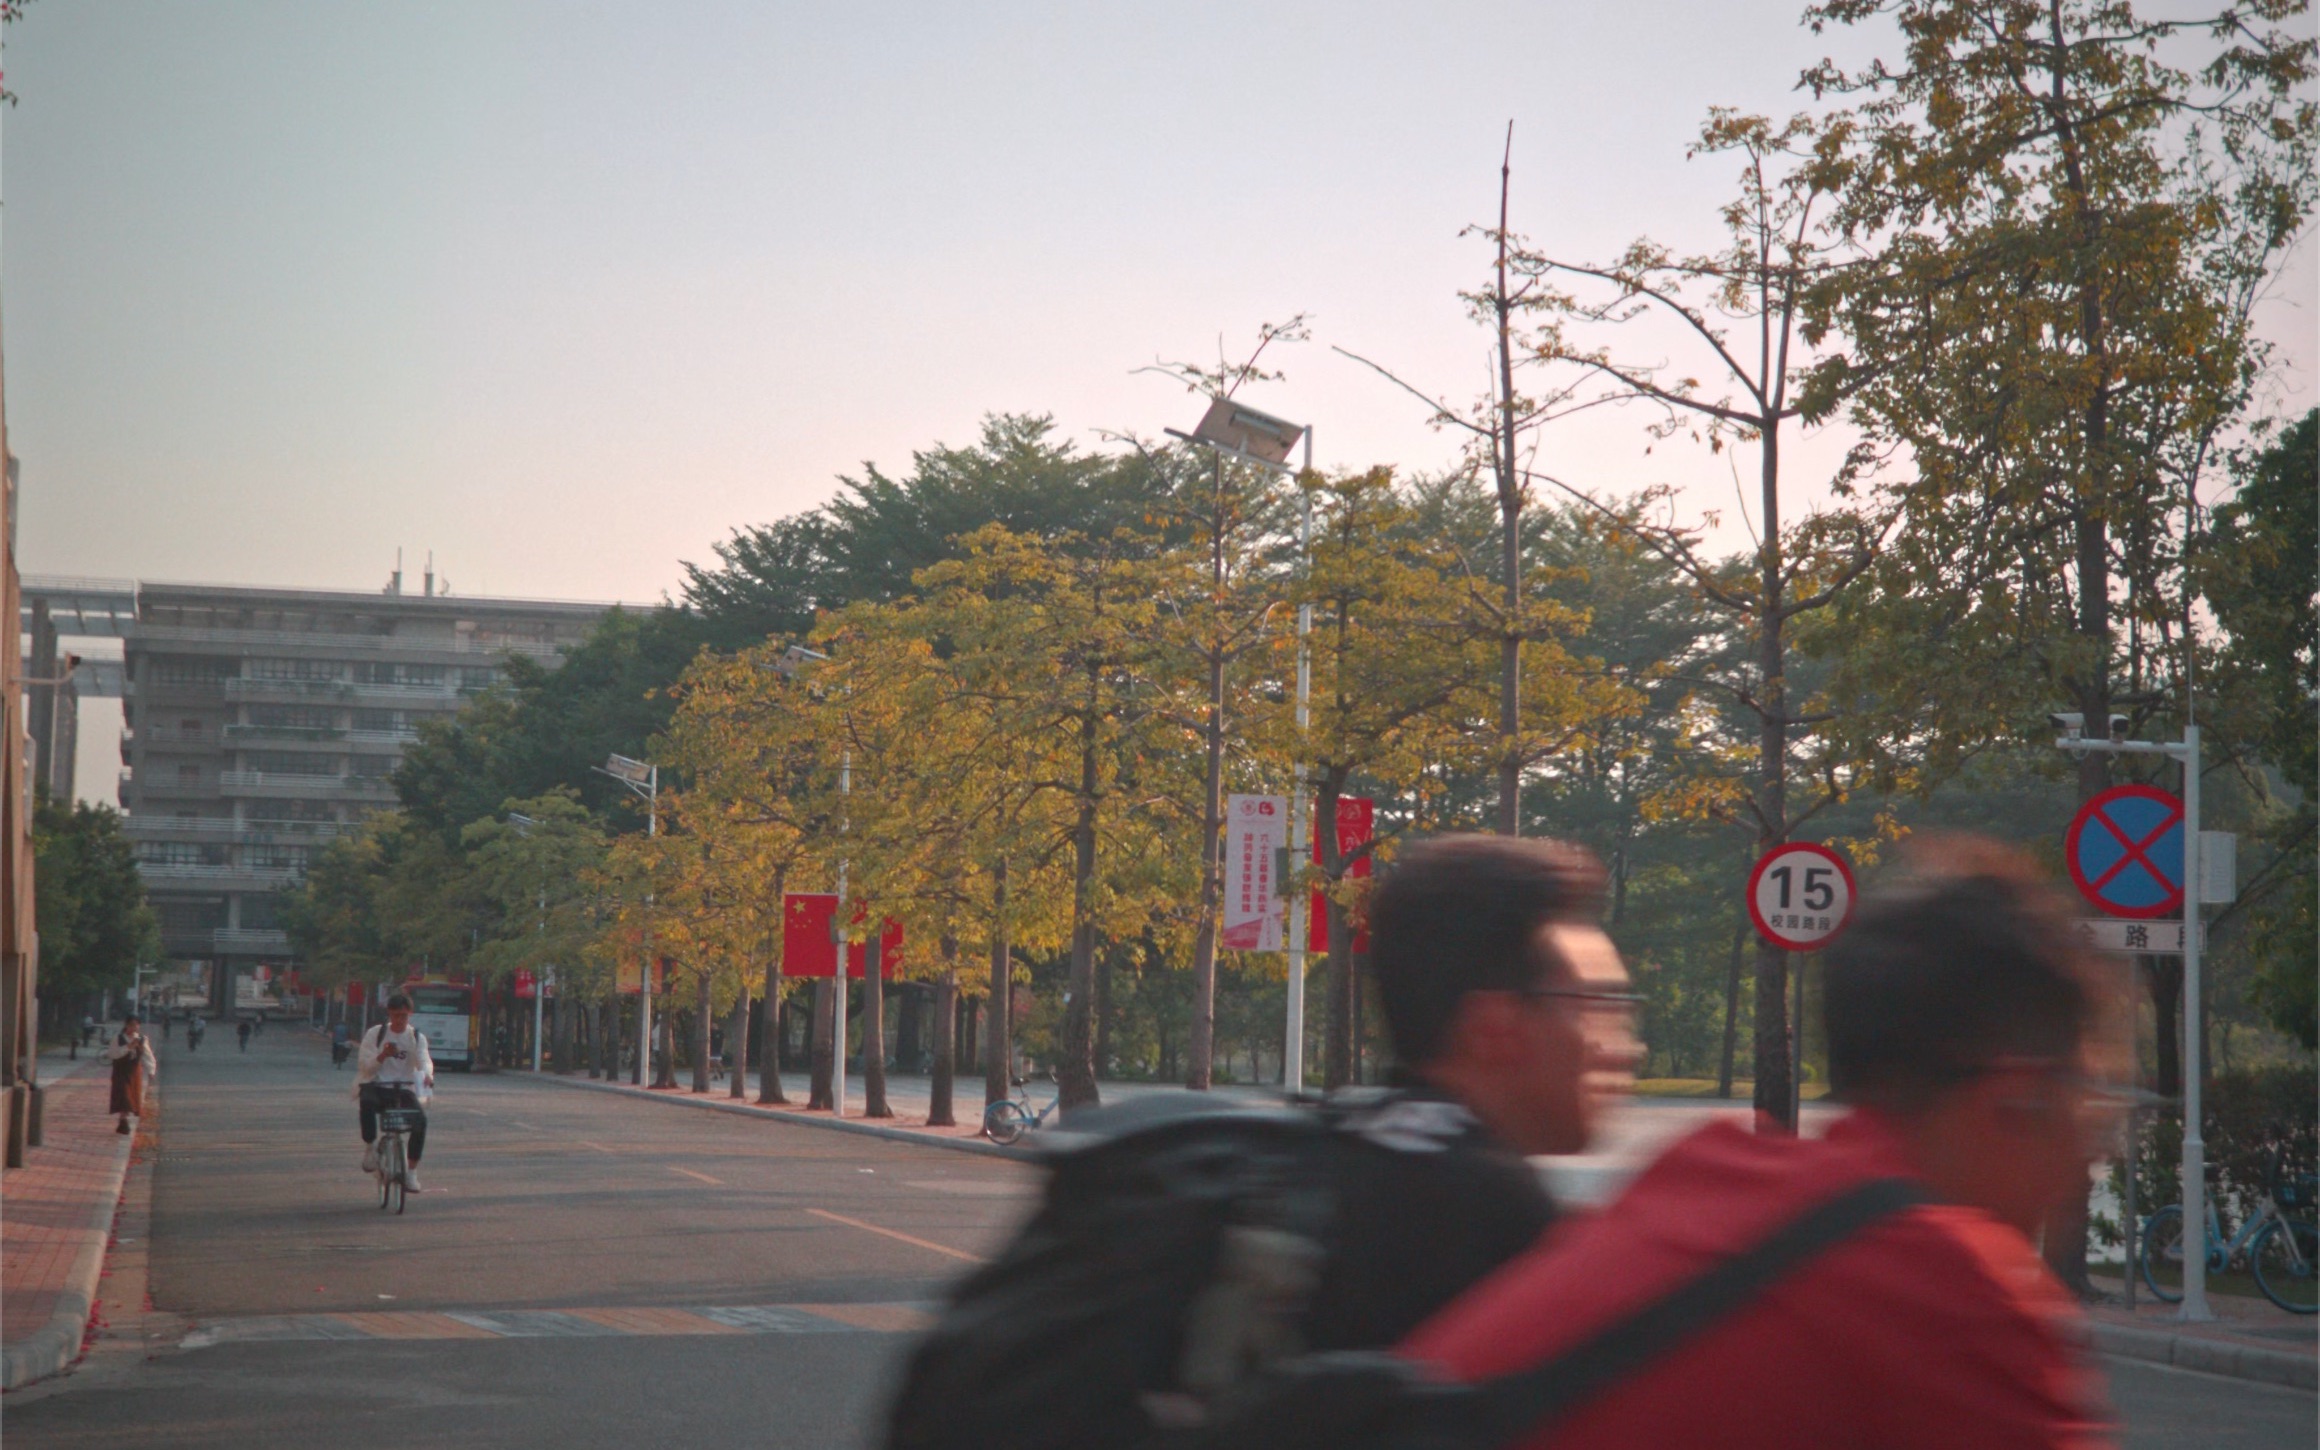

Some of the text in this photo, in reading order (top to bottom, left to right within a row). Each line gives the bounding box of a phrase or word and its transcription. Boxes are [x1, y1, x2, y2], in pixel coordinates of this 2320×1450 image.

[1770, 866, 1834, 911] 15
[1771, 915, 1831, 930] 校园路段
